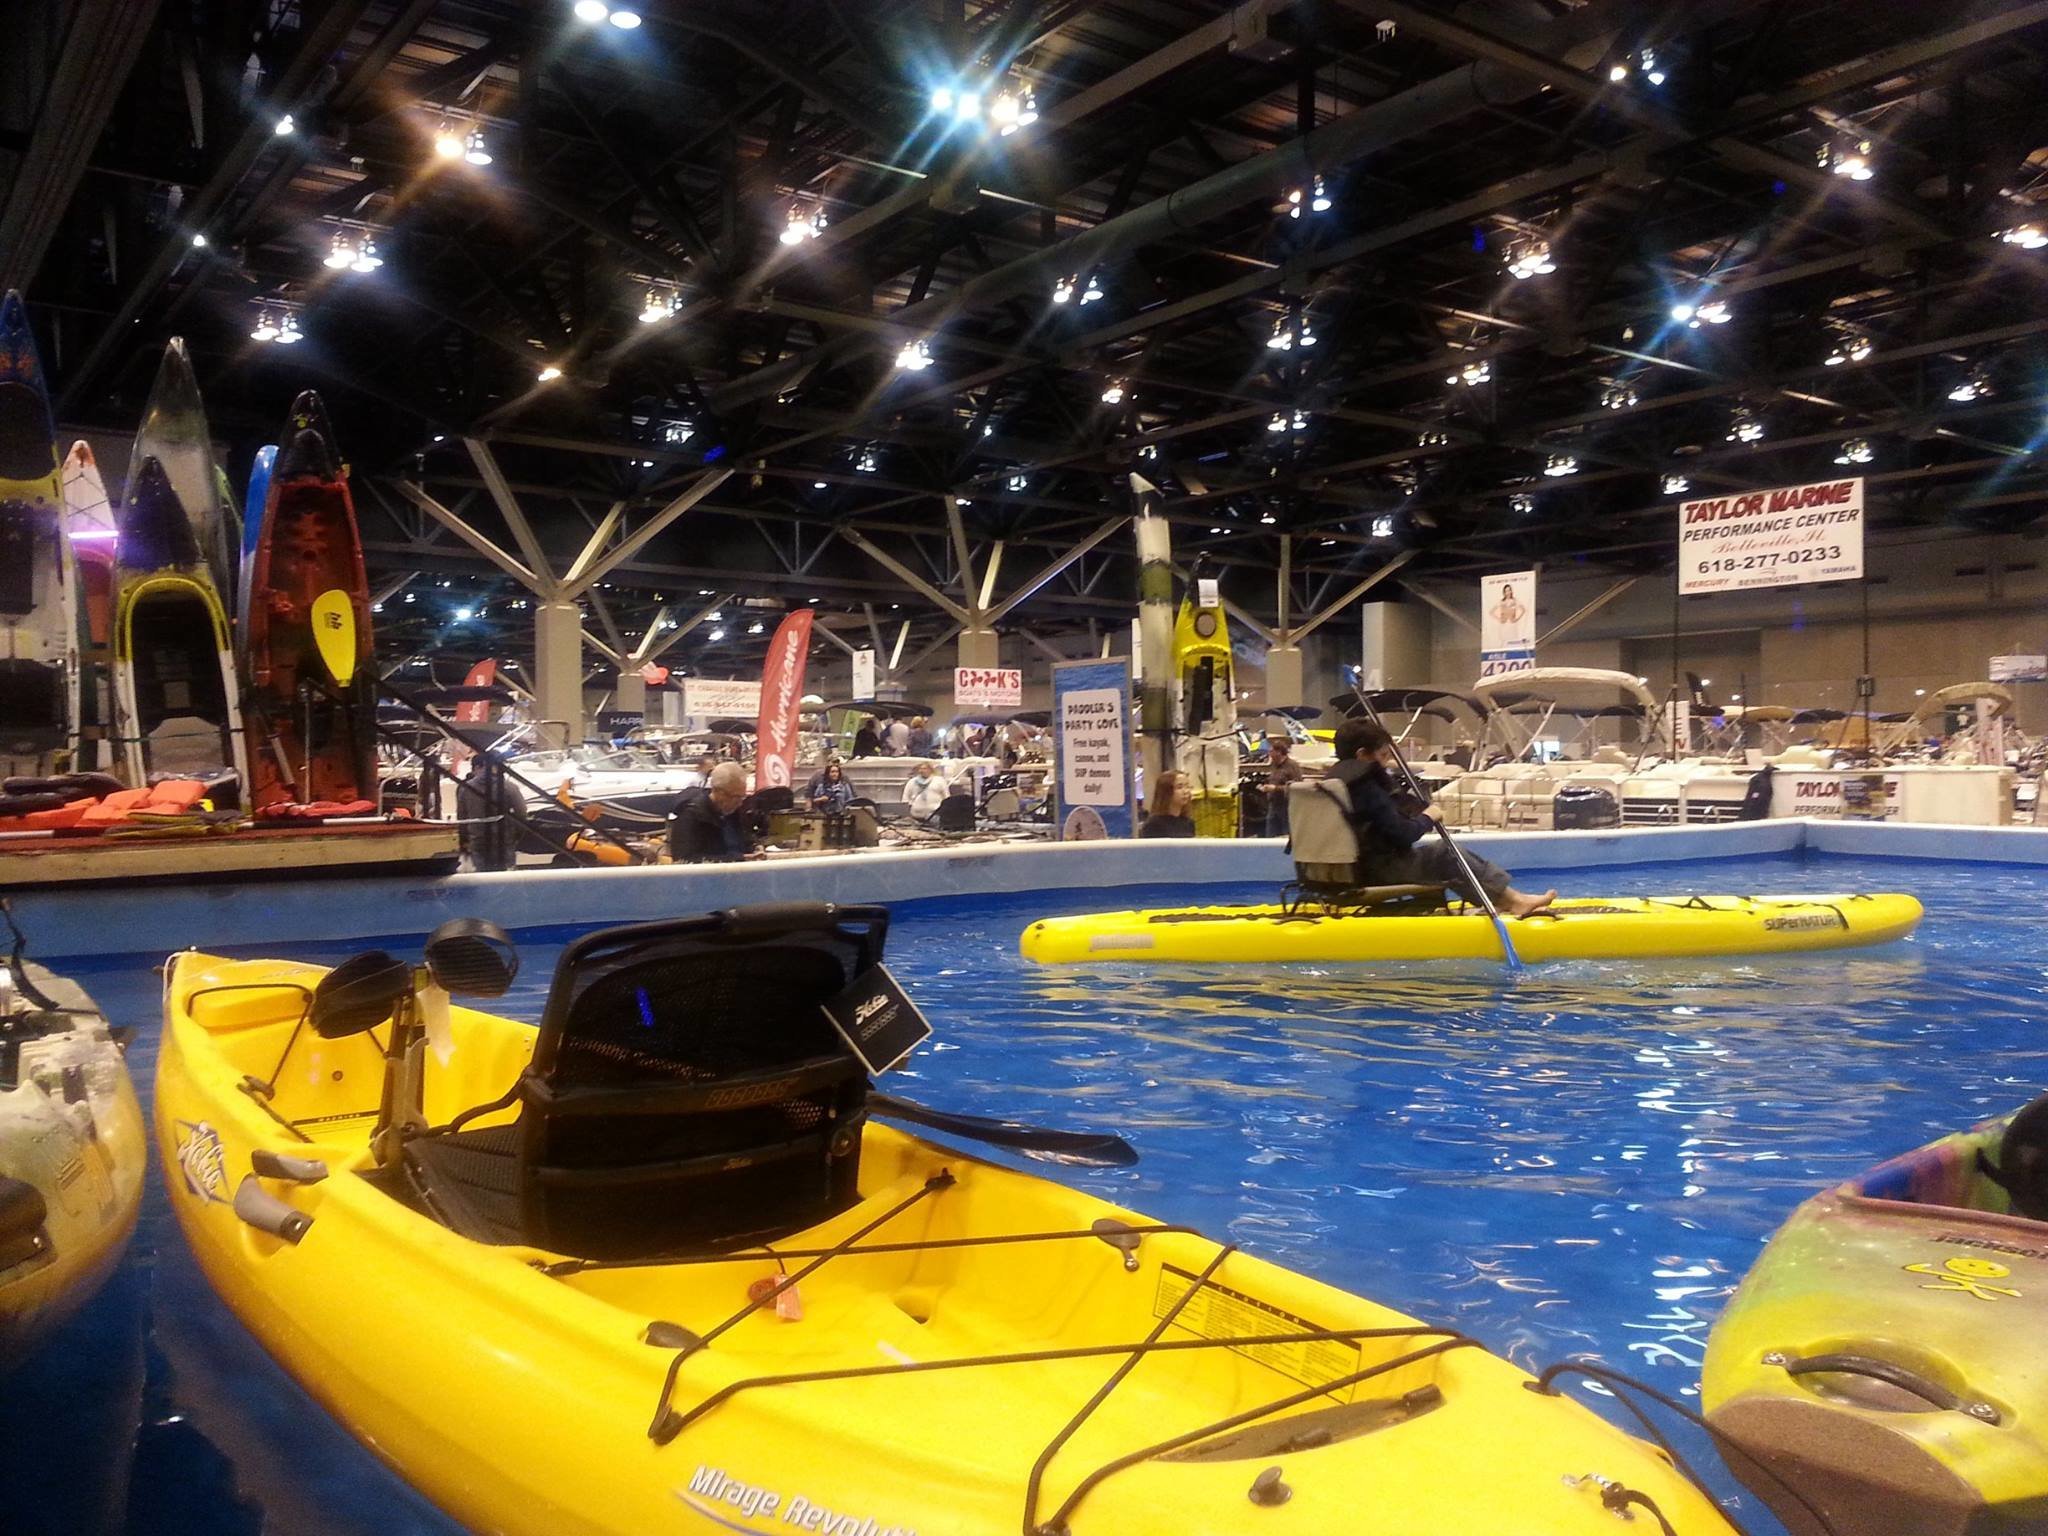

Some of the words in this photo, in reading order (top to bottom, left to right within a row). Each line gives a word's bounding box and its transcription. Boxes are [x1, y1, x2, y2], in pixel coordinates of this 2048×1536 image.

[1685, 494, 1765, 524] TAYLOR
[1768, 481, 1855, 513] MARINE
[1683, 517, 1792, 542] PERFORMANCE
[1796, 509, 1860, 529] CENTER
[1699, 546, 1841, 574] 618-277-0233
[1685, 578, 1730, 589] MERCURY
[1738, 574, 1799, 587] BENNINGTON
[1821, 566, 1857, 575] YAMAHA
[768, 630, 799, 753] Hurricane
[1065, 719, 1095, 732] PARTY
[1097, 718, 1119, 730] COVE
[1073, 738, 1087, 748] Free
[1088, 738, 1111, 749] kayak,
[1097, 753, 1110, 763] and
[1074, 768, 1087, 778] SUP
[1089, 769, 1111, 778] demos
[1084, 783, 1102, 795] daily!
[1794, 805, 1841, 816] PERFORMA
[1218, 1285, 1301, 1325] CAUTION
[688, 1465, 780, 1517] Mirage
